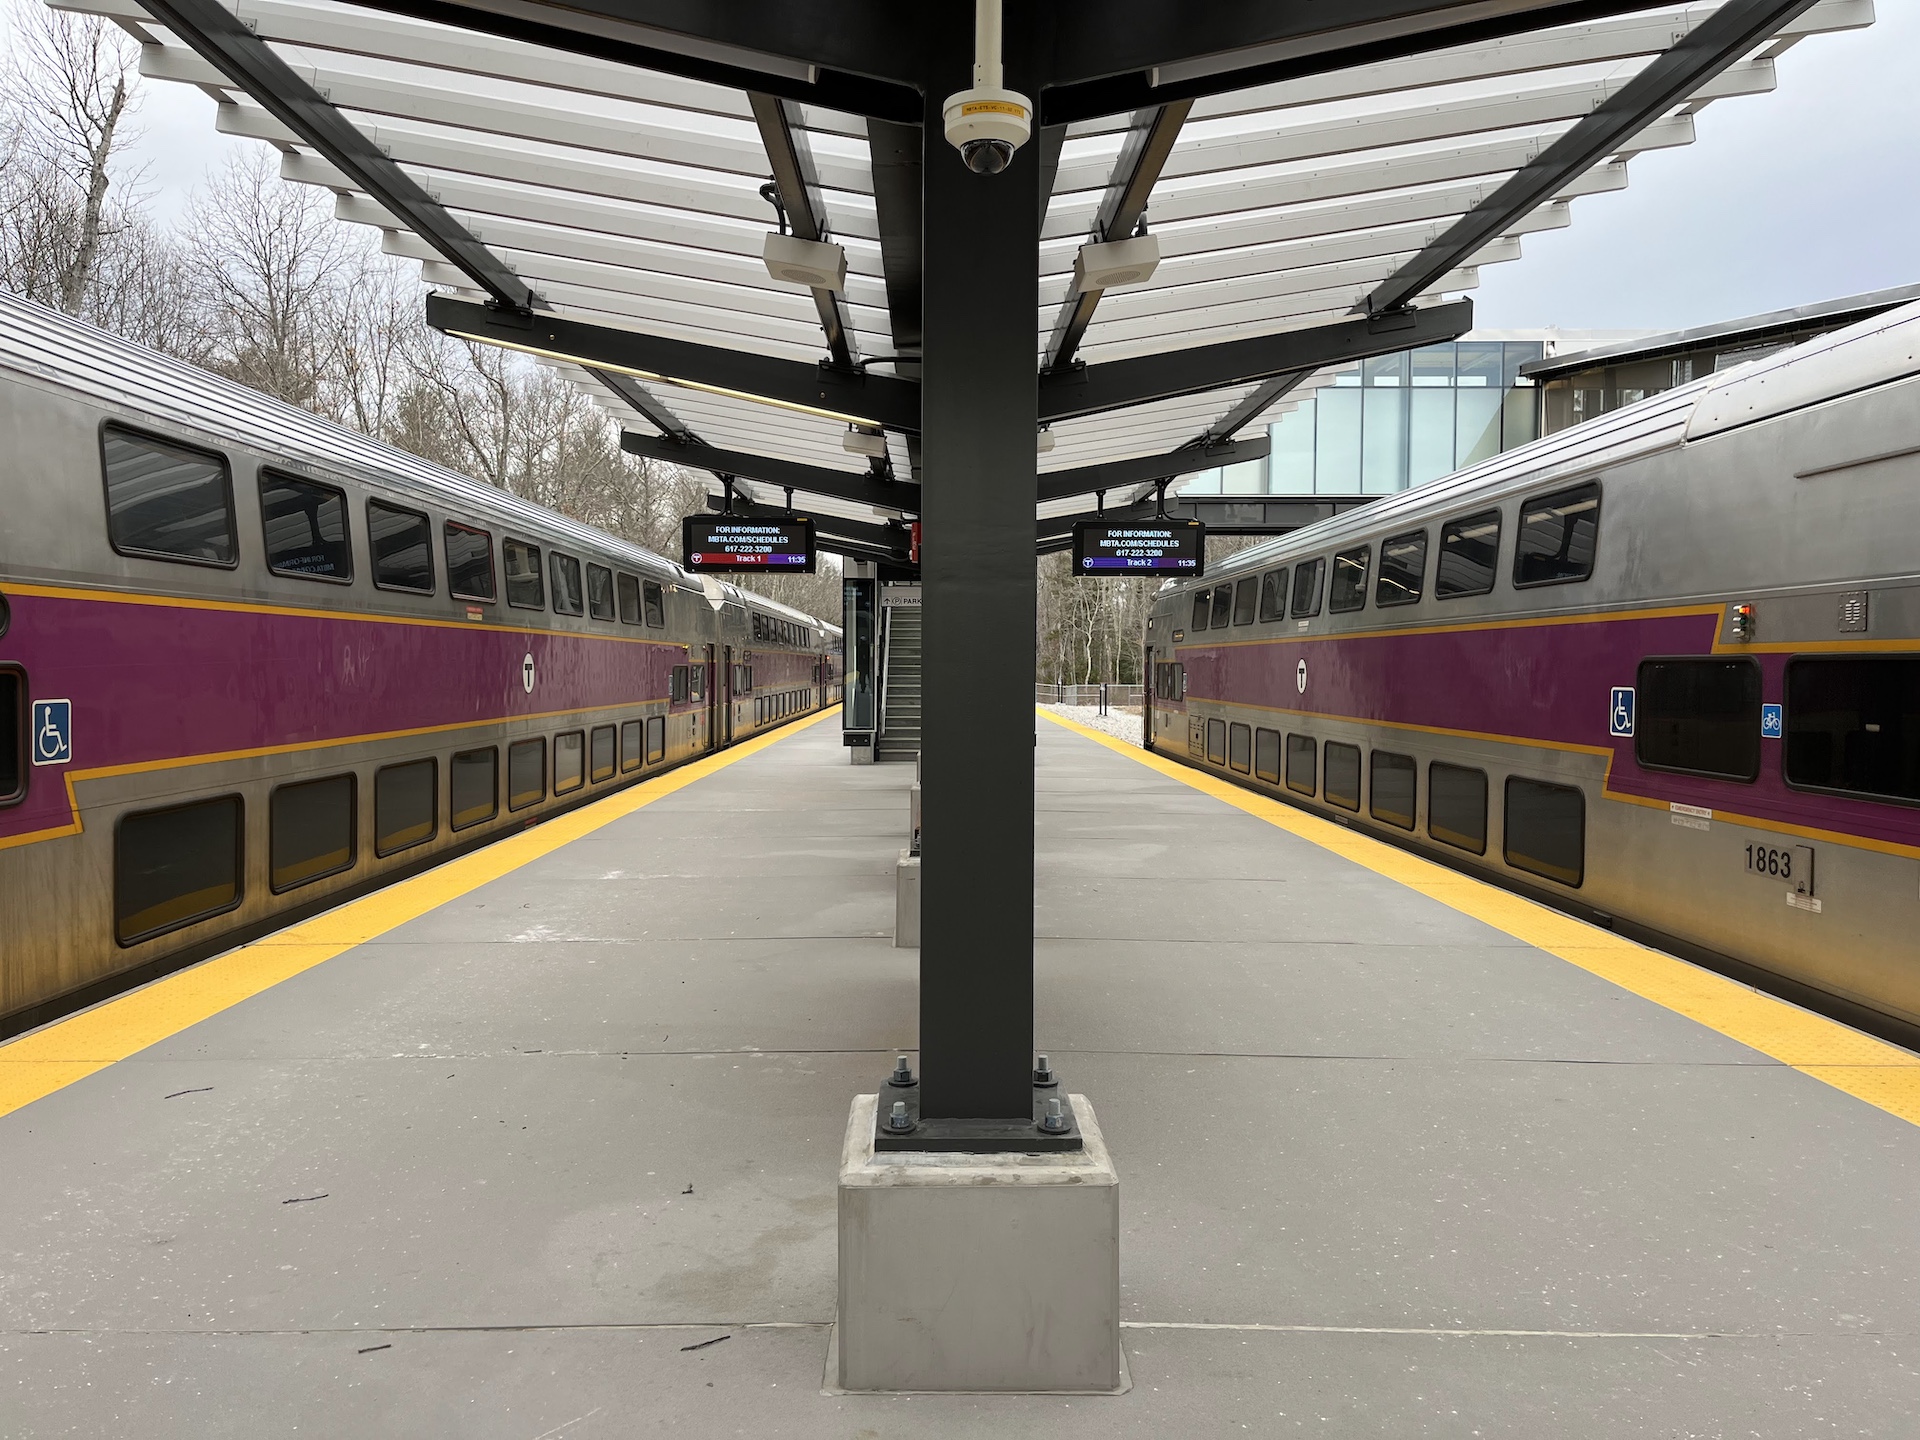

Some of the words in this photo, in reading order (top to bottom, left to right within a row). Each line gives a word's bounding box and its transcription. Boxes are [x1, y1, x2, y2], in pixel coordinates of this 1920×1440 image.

[716, 526, 730, 534] FOR
[731, 526, 780, 534] INFORMATION:
[1108, 530, 1122, 538] FOR
[1123, 530, 1171, 538] INFORMATION:
[708, 535, 788, 544] MBTA.COM/SCHEDULES
[1100, 540, 1179, 548] MBTA.COM/SCHEDULES
[725, 545, 772, 553] 617-222-3200
[1116, 549, 1163, 557] 617-222-3200
[1178, 559, 1196, 567] 11:35
[1745, 844, 1791, 878] 1863
